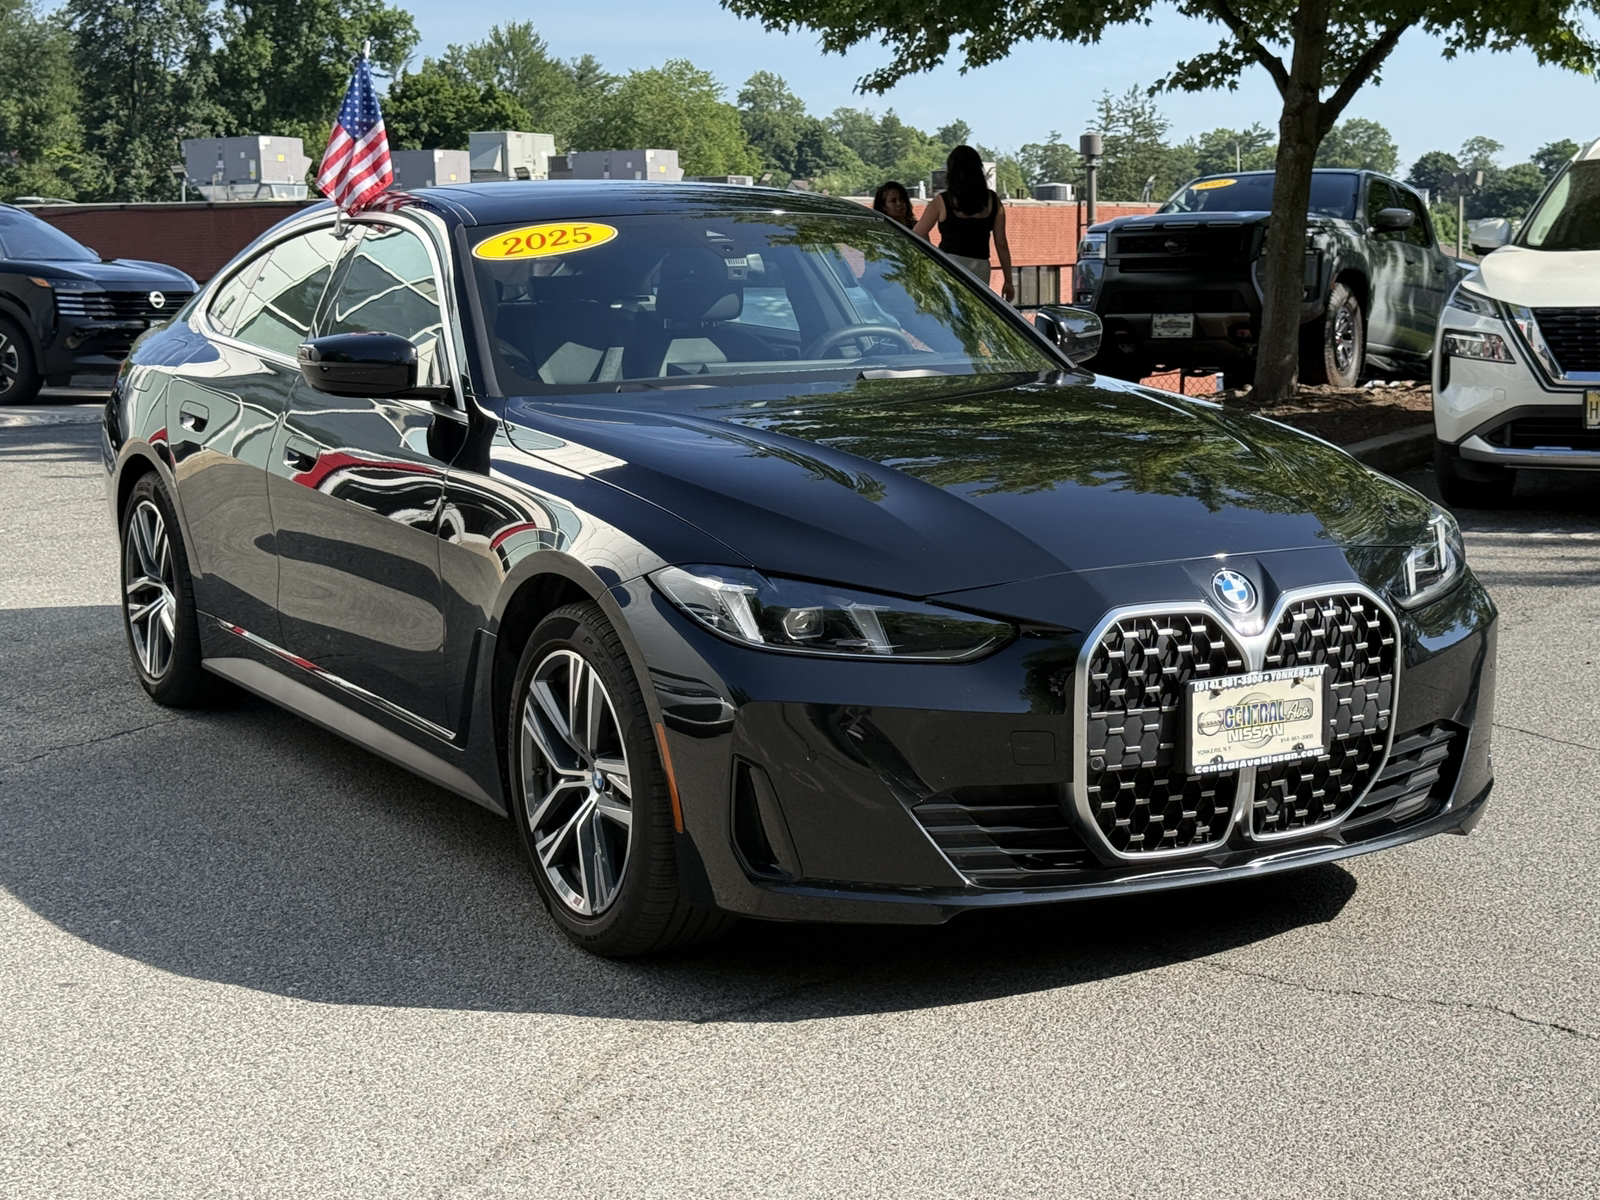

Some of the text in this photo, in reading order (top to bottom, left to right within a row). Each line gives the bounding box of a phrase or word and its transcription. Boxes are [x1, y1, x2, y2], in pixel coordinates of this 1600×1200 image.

[502, 227, 592, 256] 2025
[1589, 400, 1600, 420] H
[1223, 699, 1285, 729] CENTRAL
[1227, 723, 1285, 743] NISSAN
